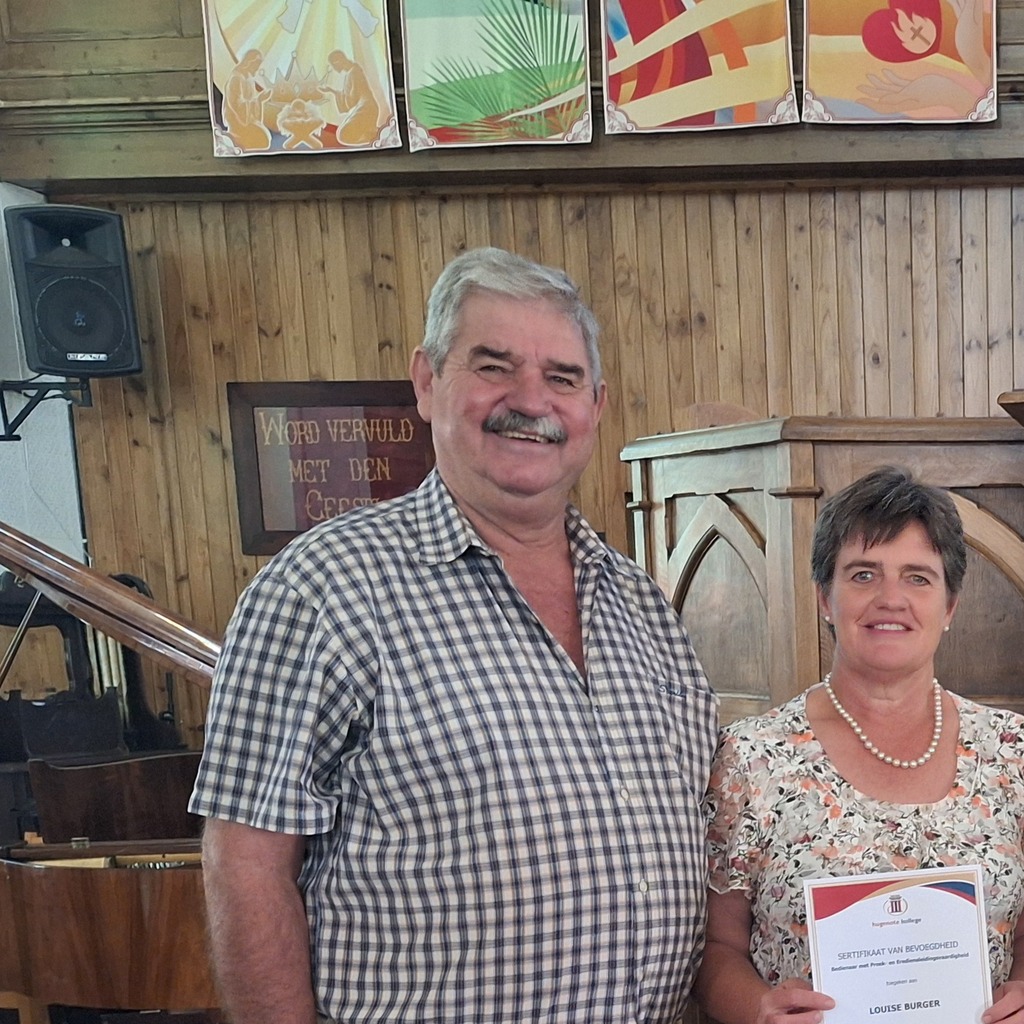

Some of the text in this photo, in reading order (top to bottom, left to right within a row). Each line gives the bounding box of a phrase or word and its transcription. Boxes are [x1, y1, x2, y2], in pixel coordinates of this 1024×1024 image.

[259, 412, 414, 446] WORD VERVULD
[289, 457, 391, 483] MET DEN
[837, 941, 959, 960] SERTIFIKAAT VAN BEVOEGDHEID
[869, 999, 940, 1015] LOUISE BURGER
